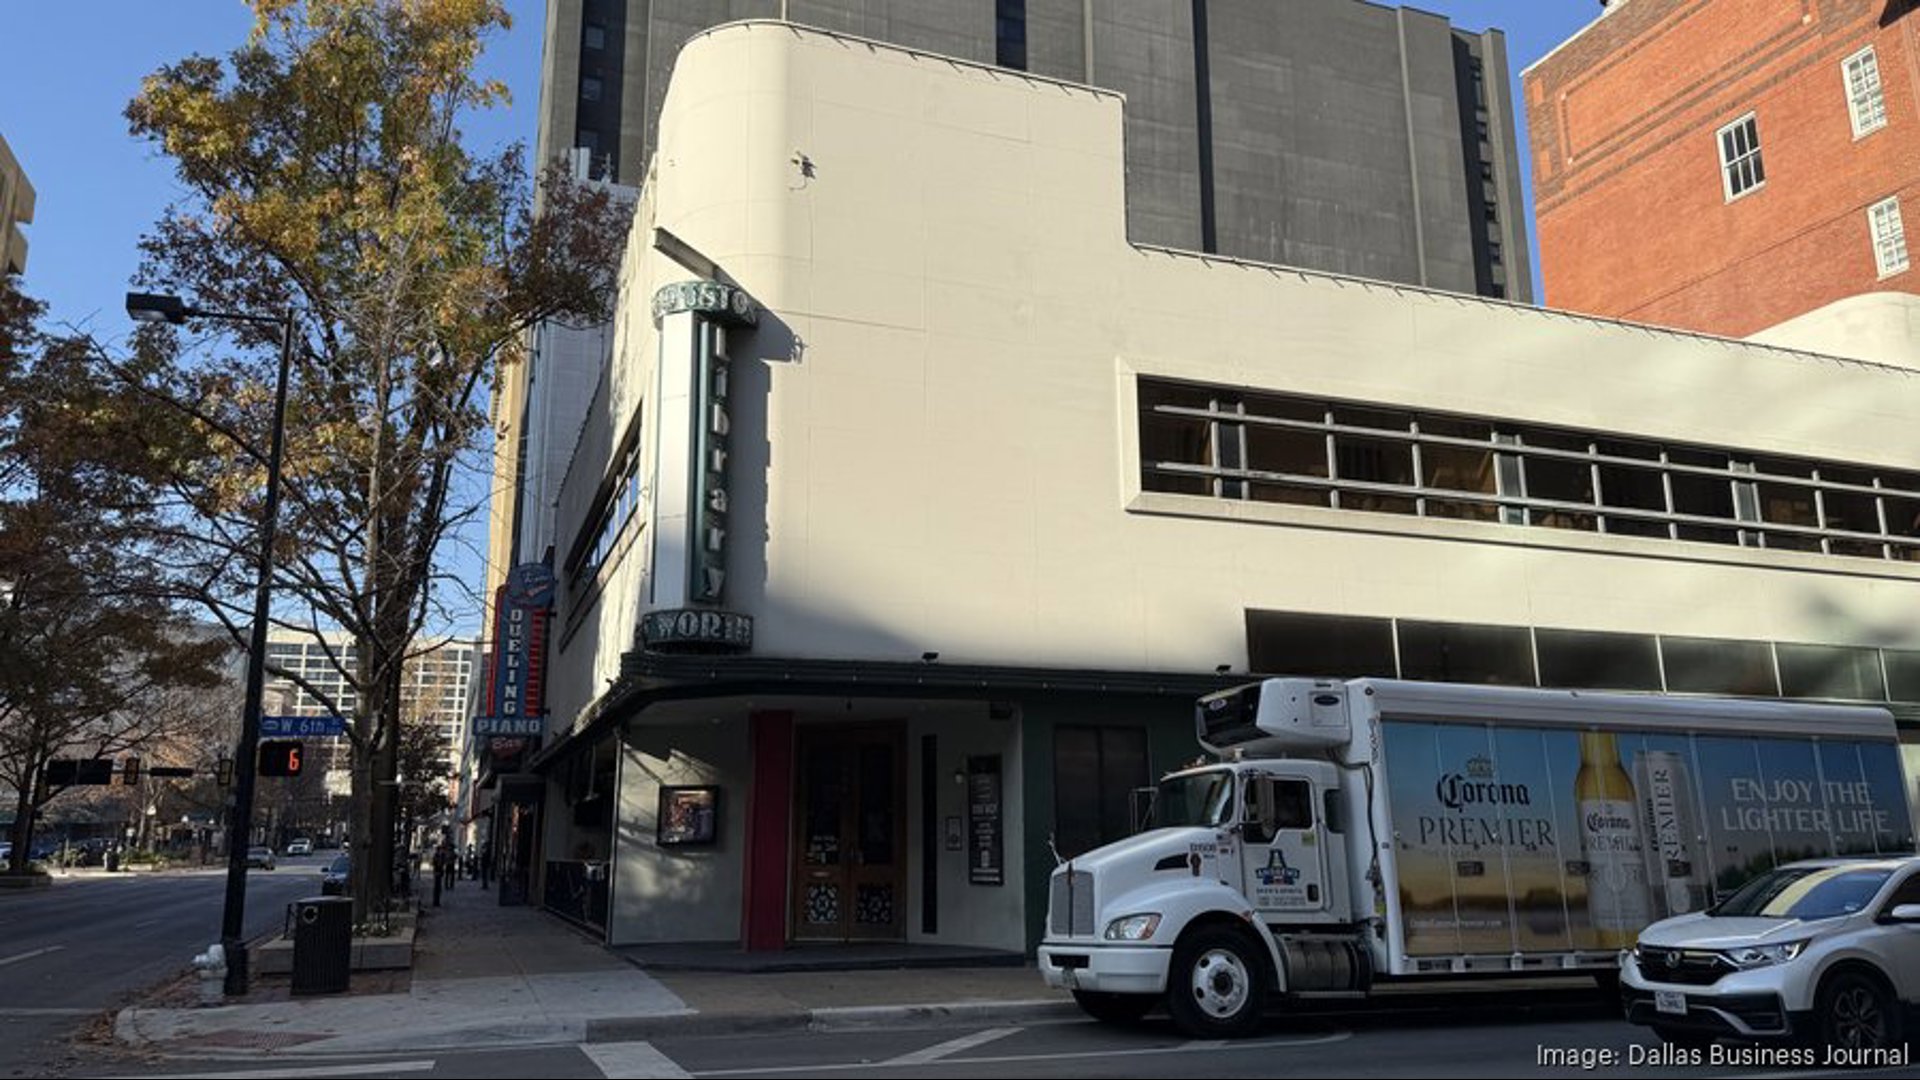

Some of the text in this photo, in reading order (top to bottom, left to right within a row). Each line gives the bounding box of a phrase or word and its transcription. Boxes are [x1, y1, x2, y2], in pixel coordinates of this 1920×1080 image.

[503, 608, 523, 715] DUELING
[281, 718, 293, 732] W
[476, 718, 541, 734] PIANO
[289, 748, 300, 771] 6
[1436, 773, 1532, 812] Corona
[1731, 778, 1875, 805] ENJOY THE
[1655, 769, 1681, 862] REMIER
[1721, 806, 1893, 833] LIGHTER LIFE
[1418, 815, 1555, 847] PREMIER
